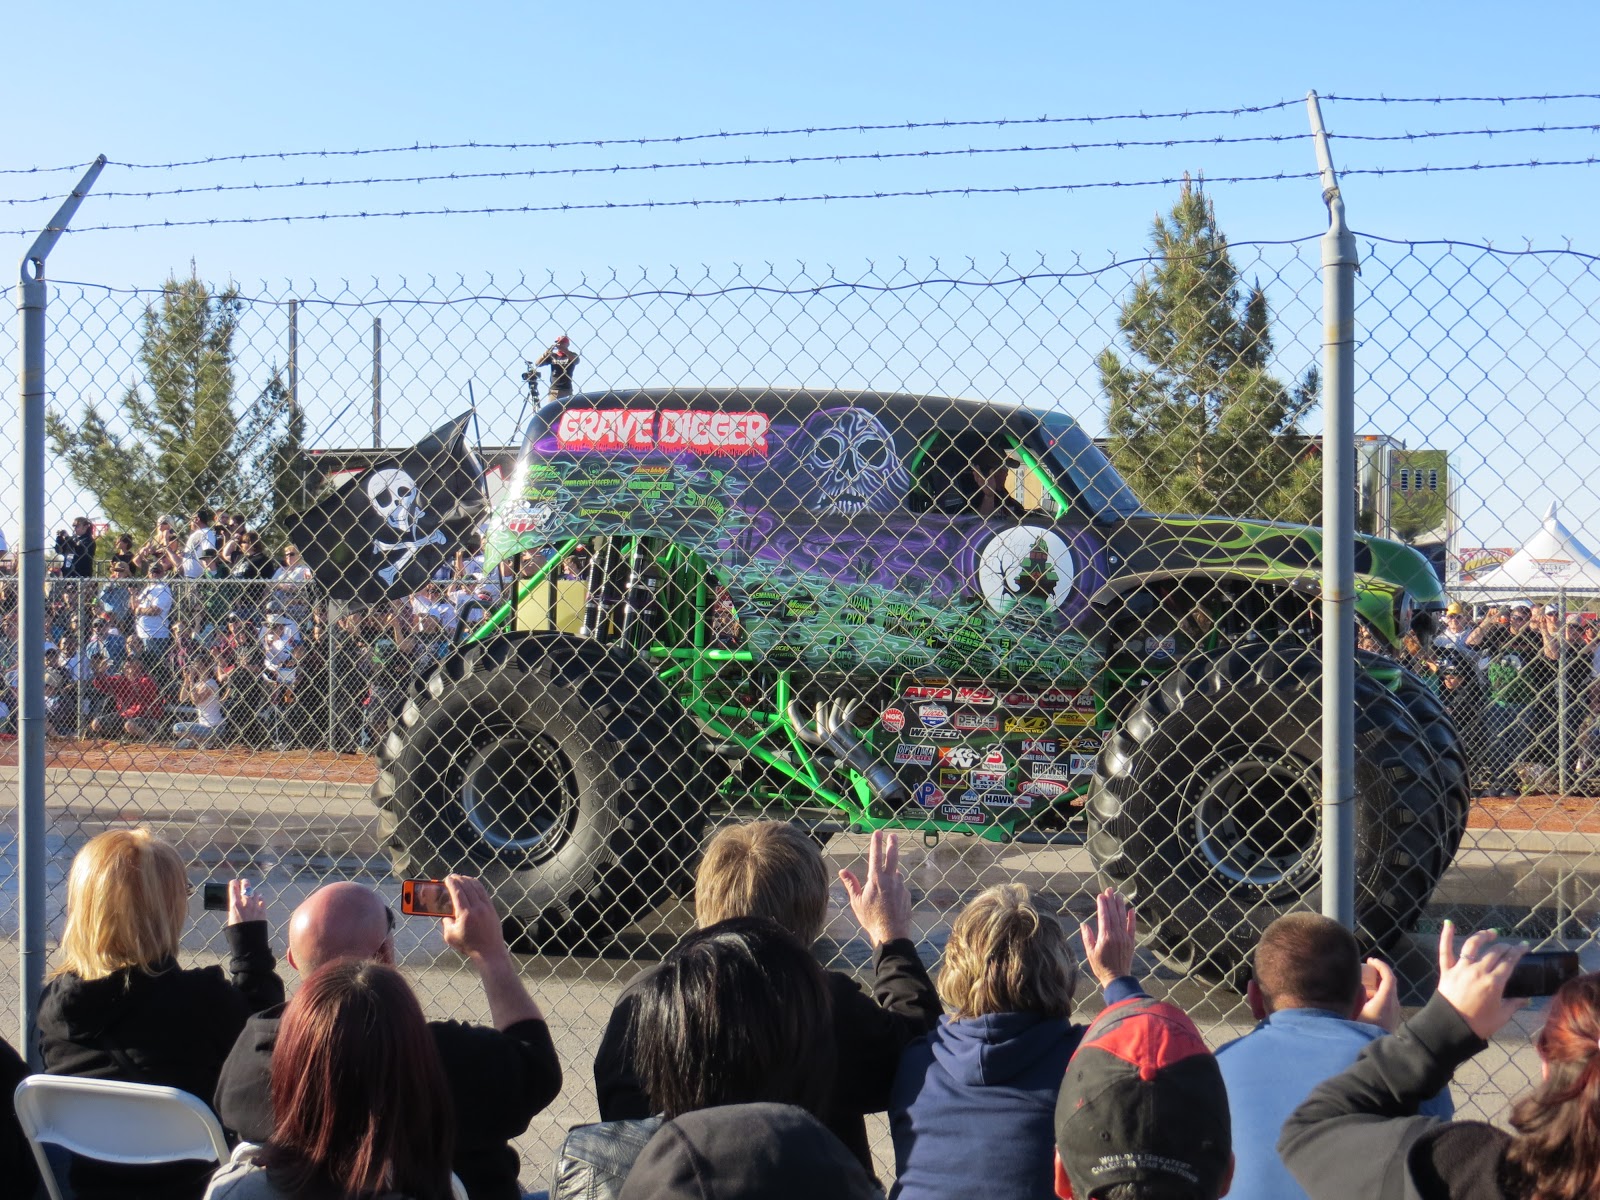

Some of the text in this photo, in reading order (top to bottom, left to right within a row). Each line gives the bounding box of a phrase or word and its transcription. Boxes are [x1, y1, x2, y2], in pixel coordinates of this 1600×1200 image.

[558, 410, 768, 446] GRAVE DIGGER
[564, 479, 620, 487] WWW.GRAVEIGGER.COM
[942, 632, 992, 651] ANDERSN
[903, 687, 951, 697] ARP
[958, 687, 995, 699] MSD
[1042, 691, 1072, 702] Coan
[1021, 741, 1056, 752] KING
[946, 747, 980, 768] K&N
[1033, 763, 1067, 776] CROWER
[913, 782, 935, 805] VP
[985, 795, 1014, 803] HAWK
[944, 806, 978, 814] LINCOLN
